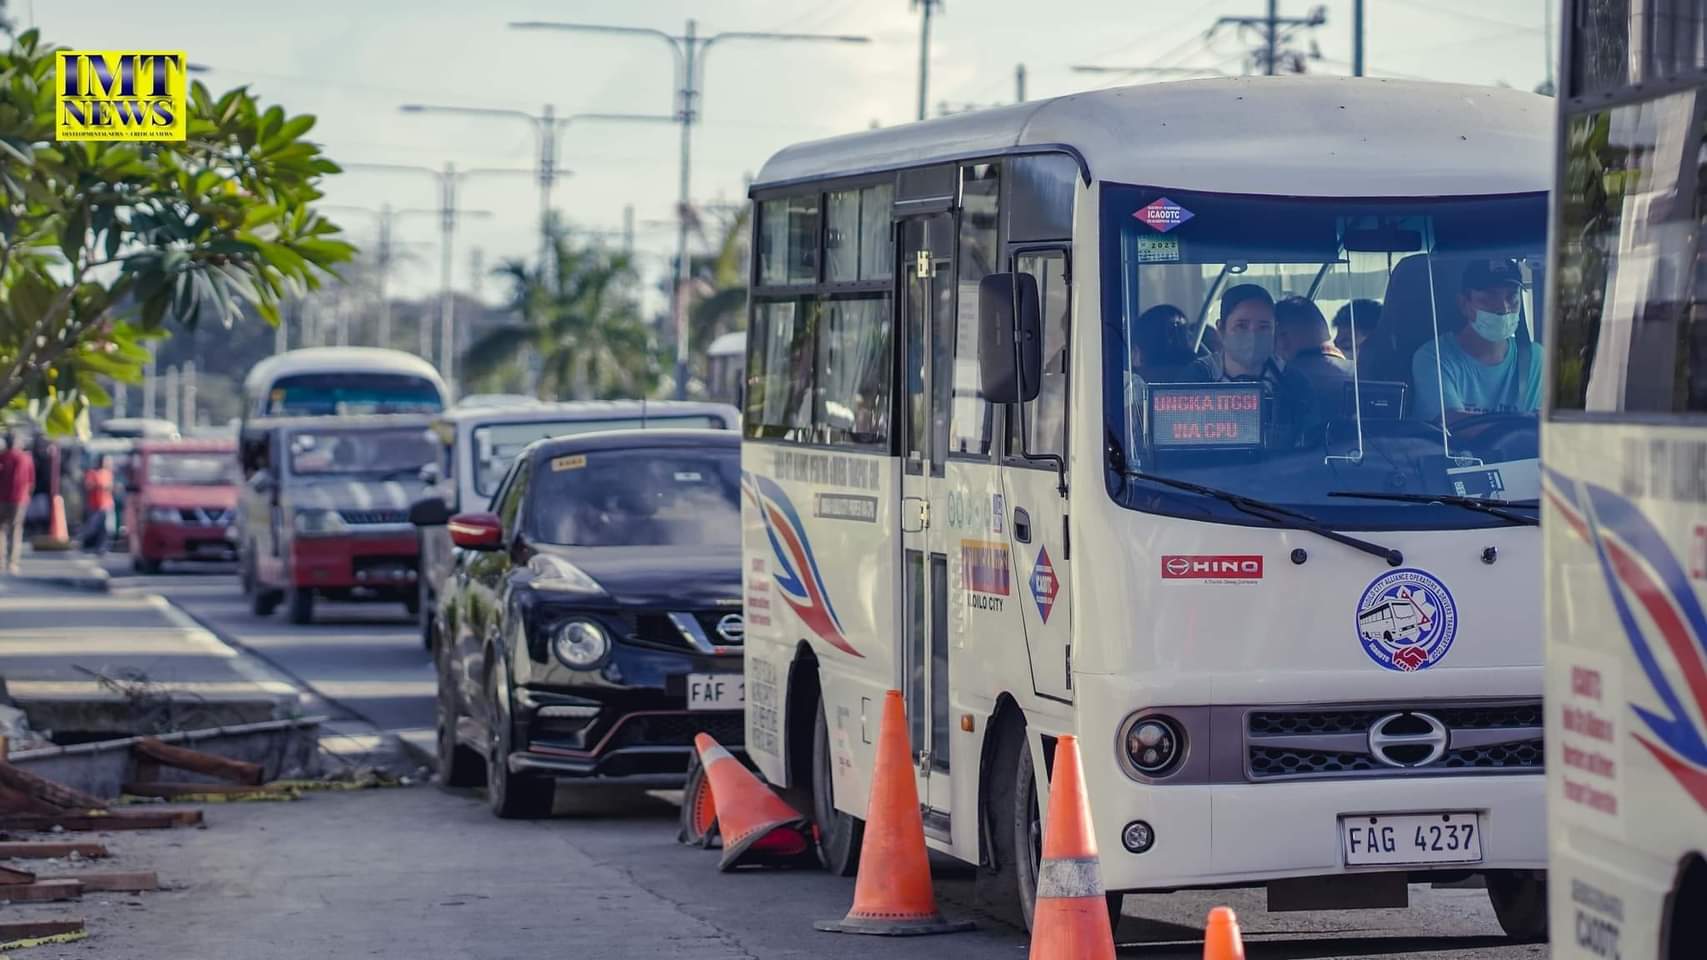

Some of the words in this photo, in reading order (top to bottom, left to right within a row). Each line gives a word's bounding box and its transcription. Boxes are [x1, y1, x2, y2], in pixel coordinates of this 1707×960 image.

[1193, 561, 1258, 572] HINO
[988, 597, 1004, 612] CITY
[692, 683, 724, 702] FAF
[1349, 826, 1396, 853] FAG
[1415, 824, 1473, 851] 4237
